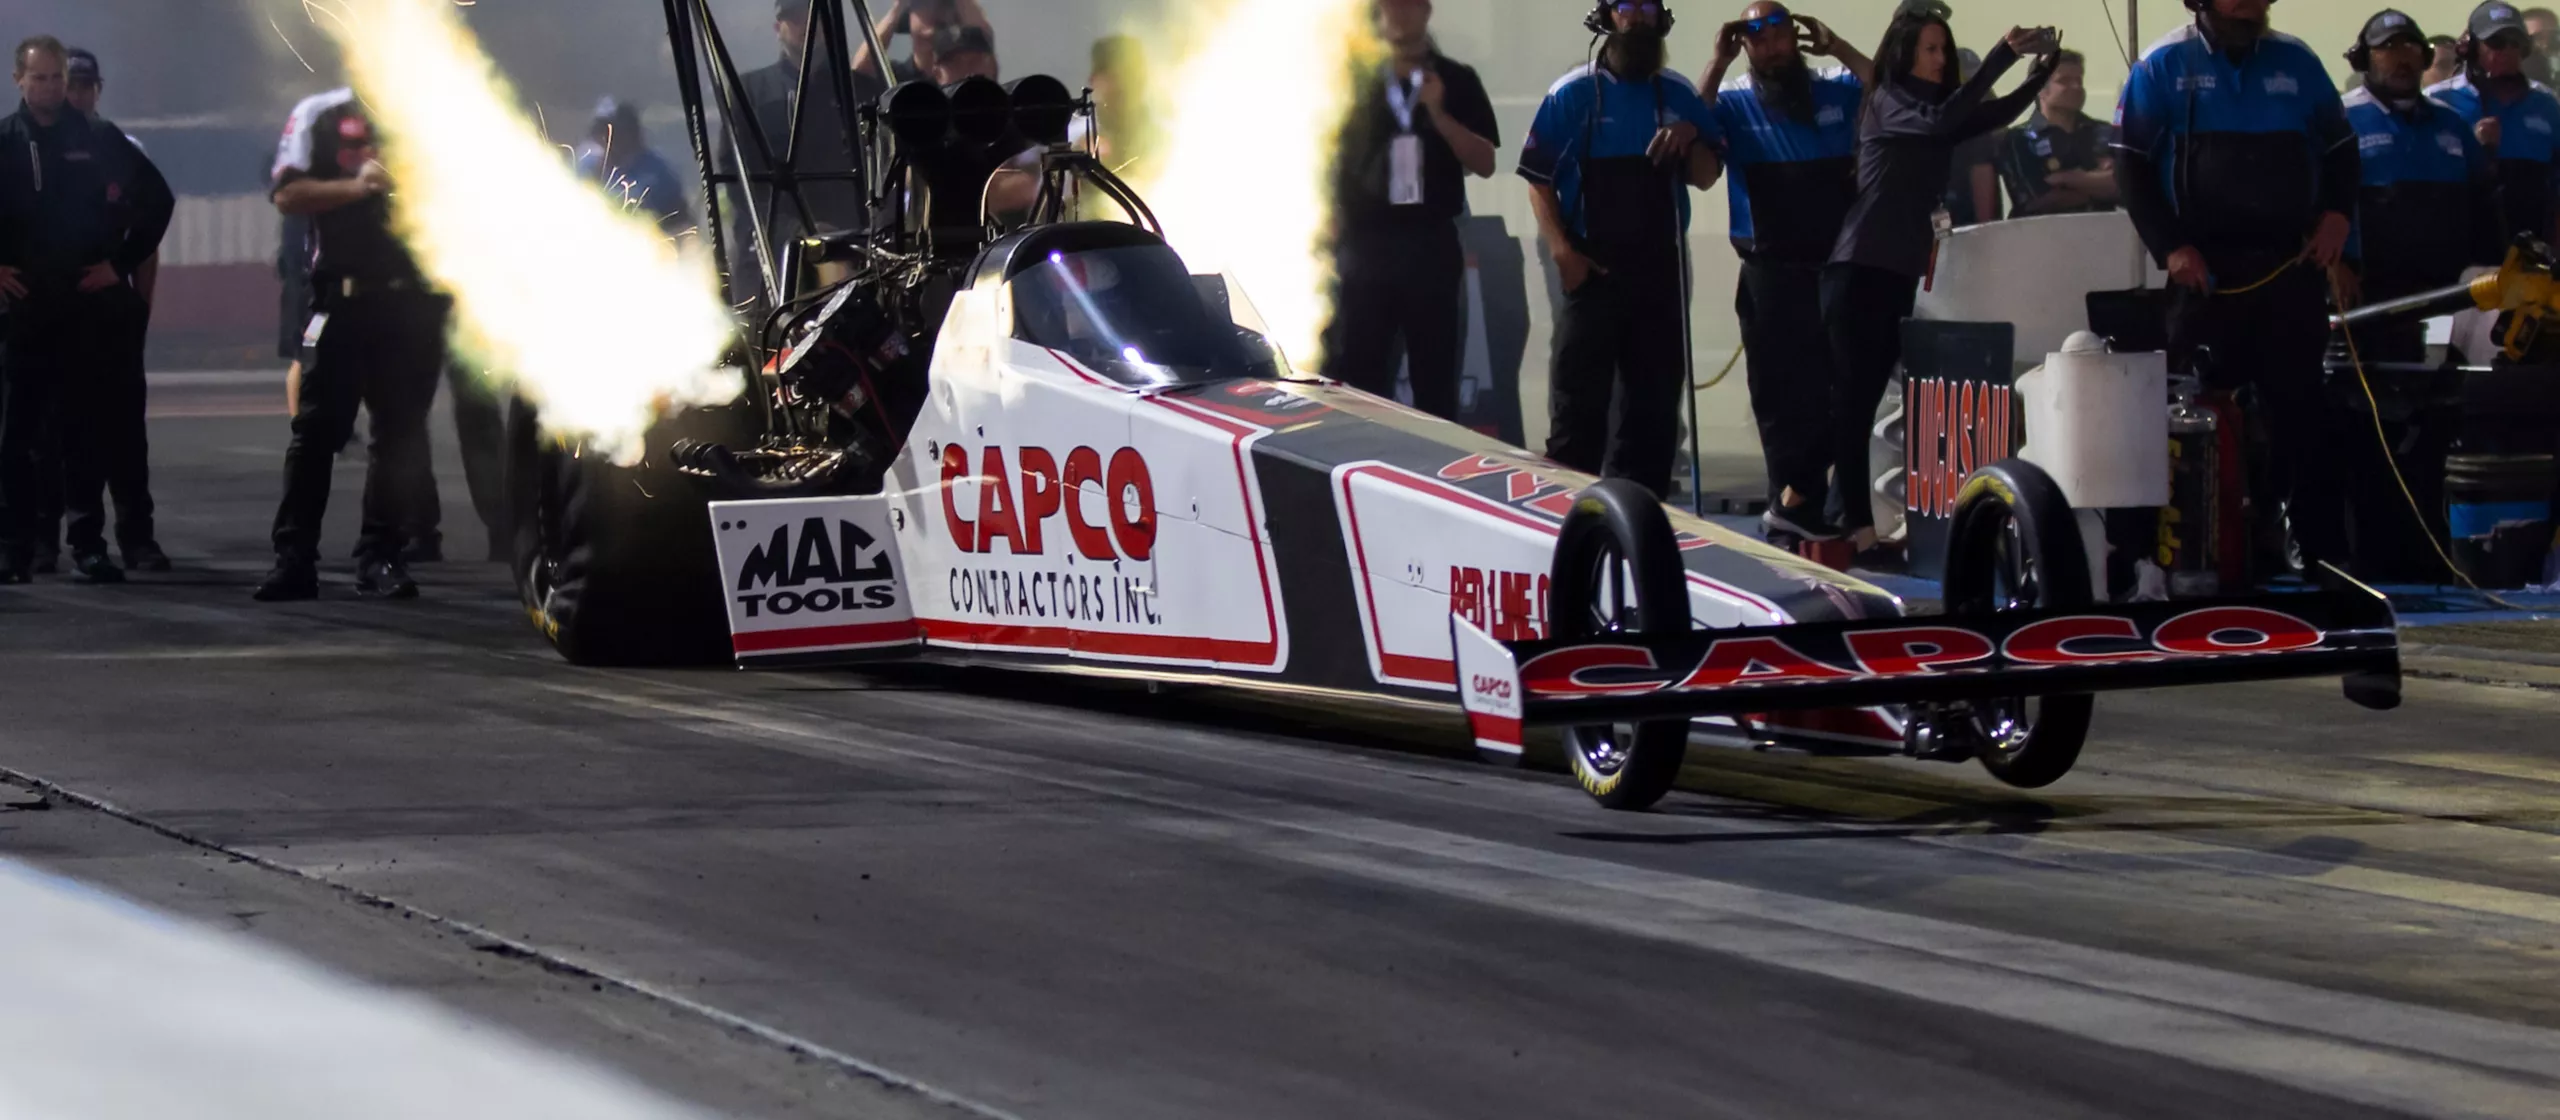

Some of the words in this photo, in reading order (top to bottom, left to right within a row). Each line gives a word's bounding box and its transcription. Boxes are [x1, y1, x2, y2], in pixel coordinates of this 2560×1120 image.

[1907, 376, 1974, 519] LUCAS
[941, 442, 1158, 561] CAPCO
[737, 517, 894, 591] MAC
[737, 585, 896, 618] TOOLS
[950, 567, 1104, 622] CONTRACTORS
[1450, 565, 1486, 633] RED
[1488, 569, 1539, 641] LINE
[1473, 674, 1512, 698] CAPCO
[1521, 606, 2324, 694] CAPCO
